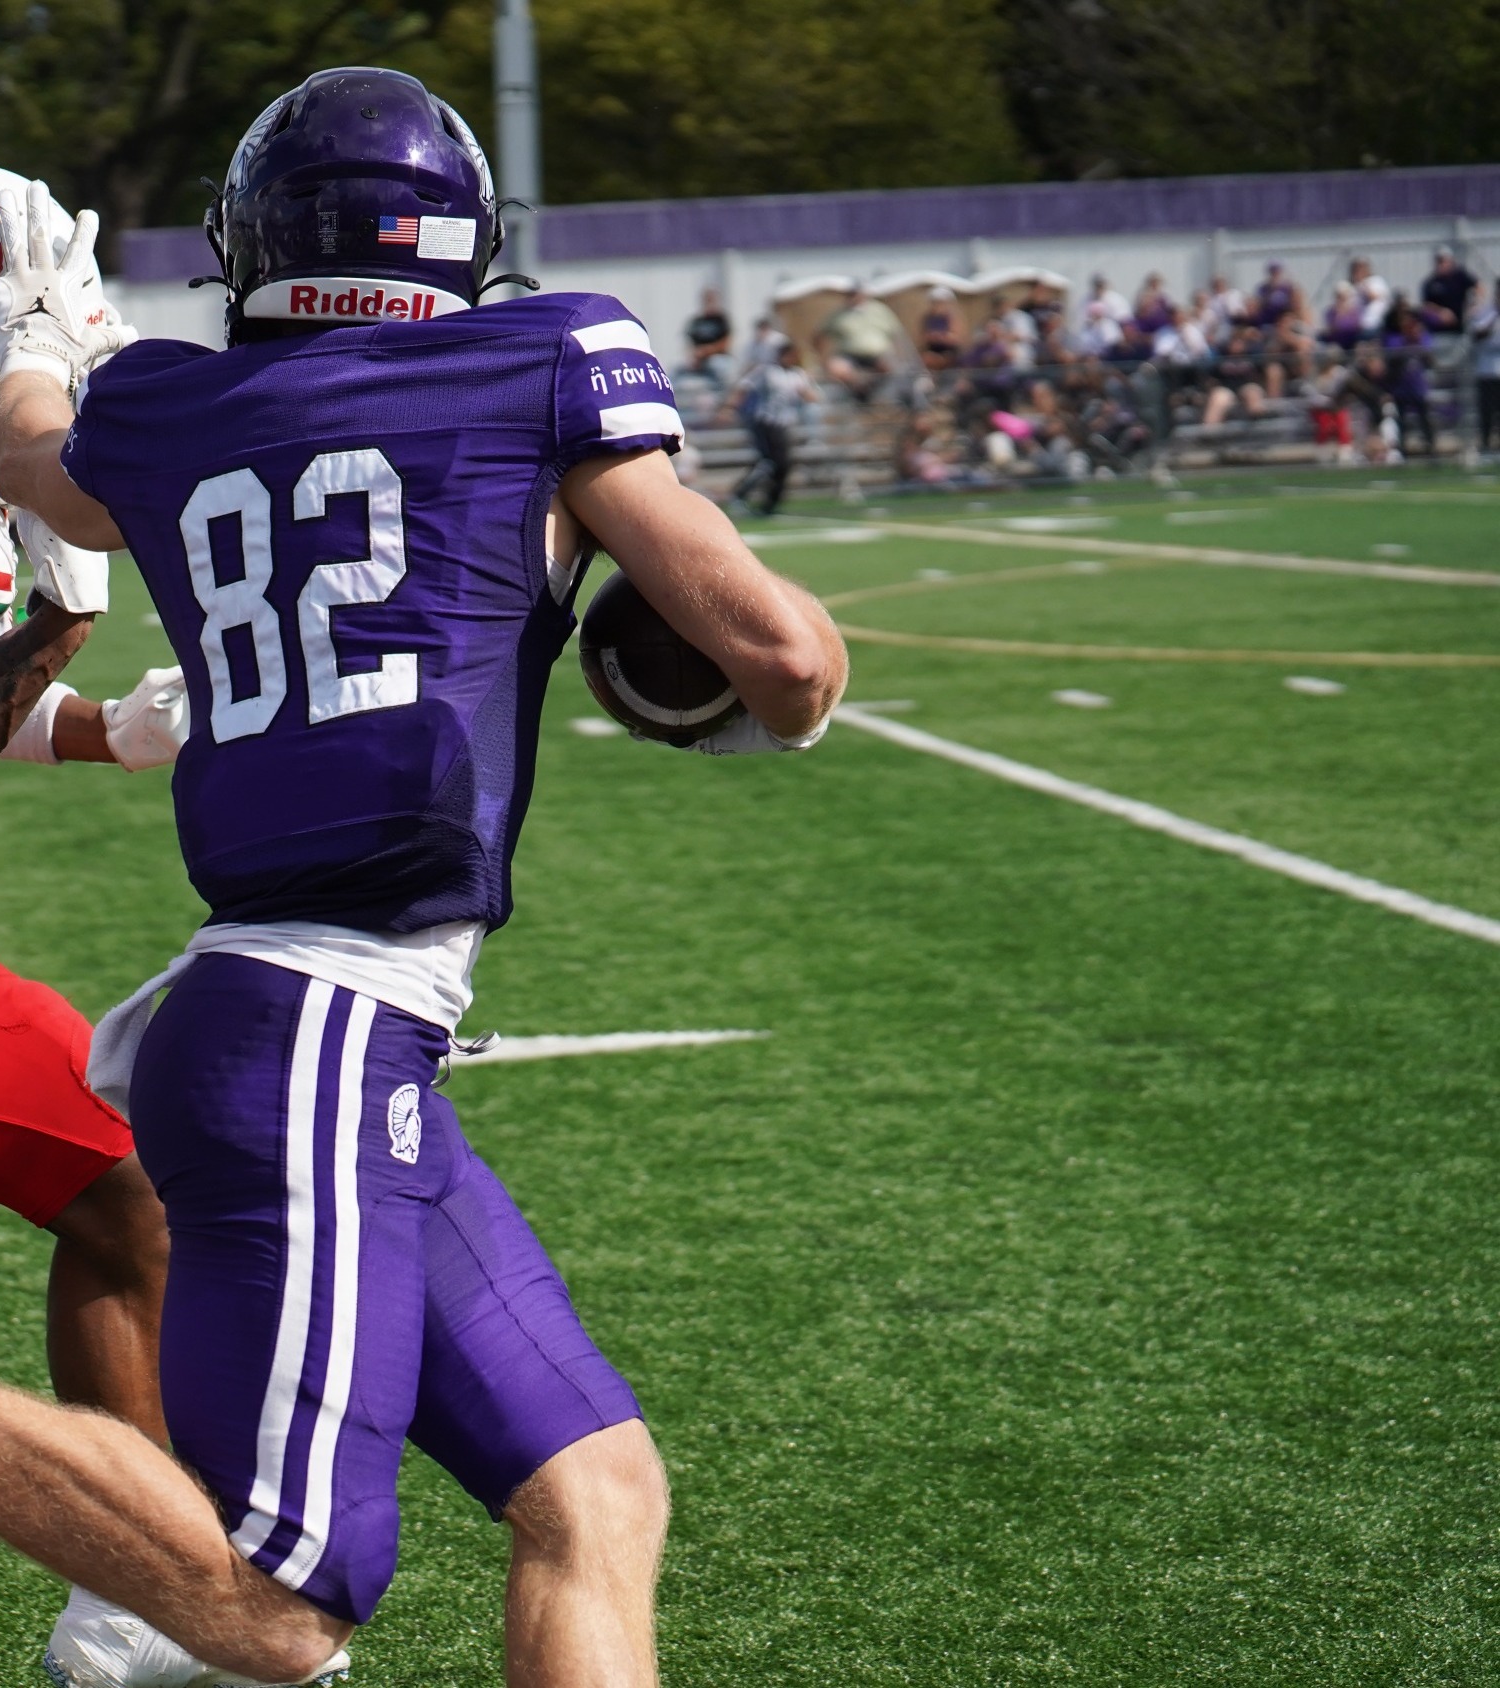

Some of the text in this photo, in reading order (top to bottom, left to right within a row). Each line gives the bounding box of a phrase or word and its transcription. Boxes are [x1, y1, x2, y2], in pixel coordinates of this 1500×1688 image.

[86, 308, 104, 325] dell
[290, 285, 436, 321] Riddell
[178, 447, 418, 745] 82
